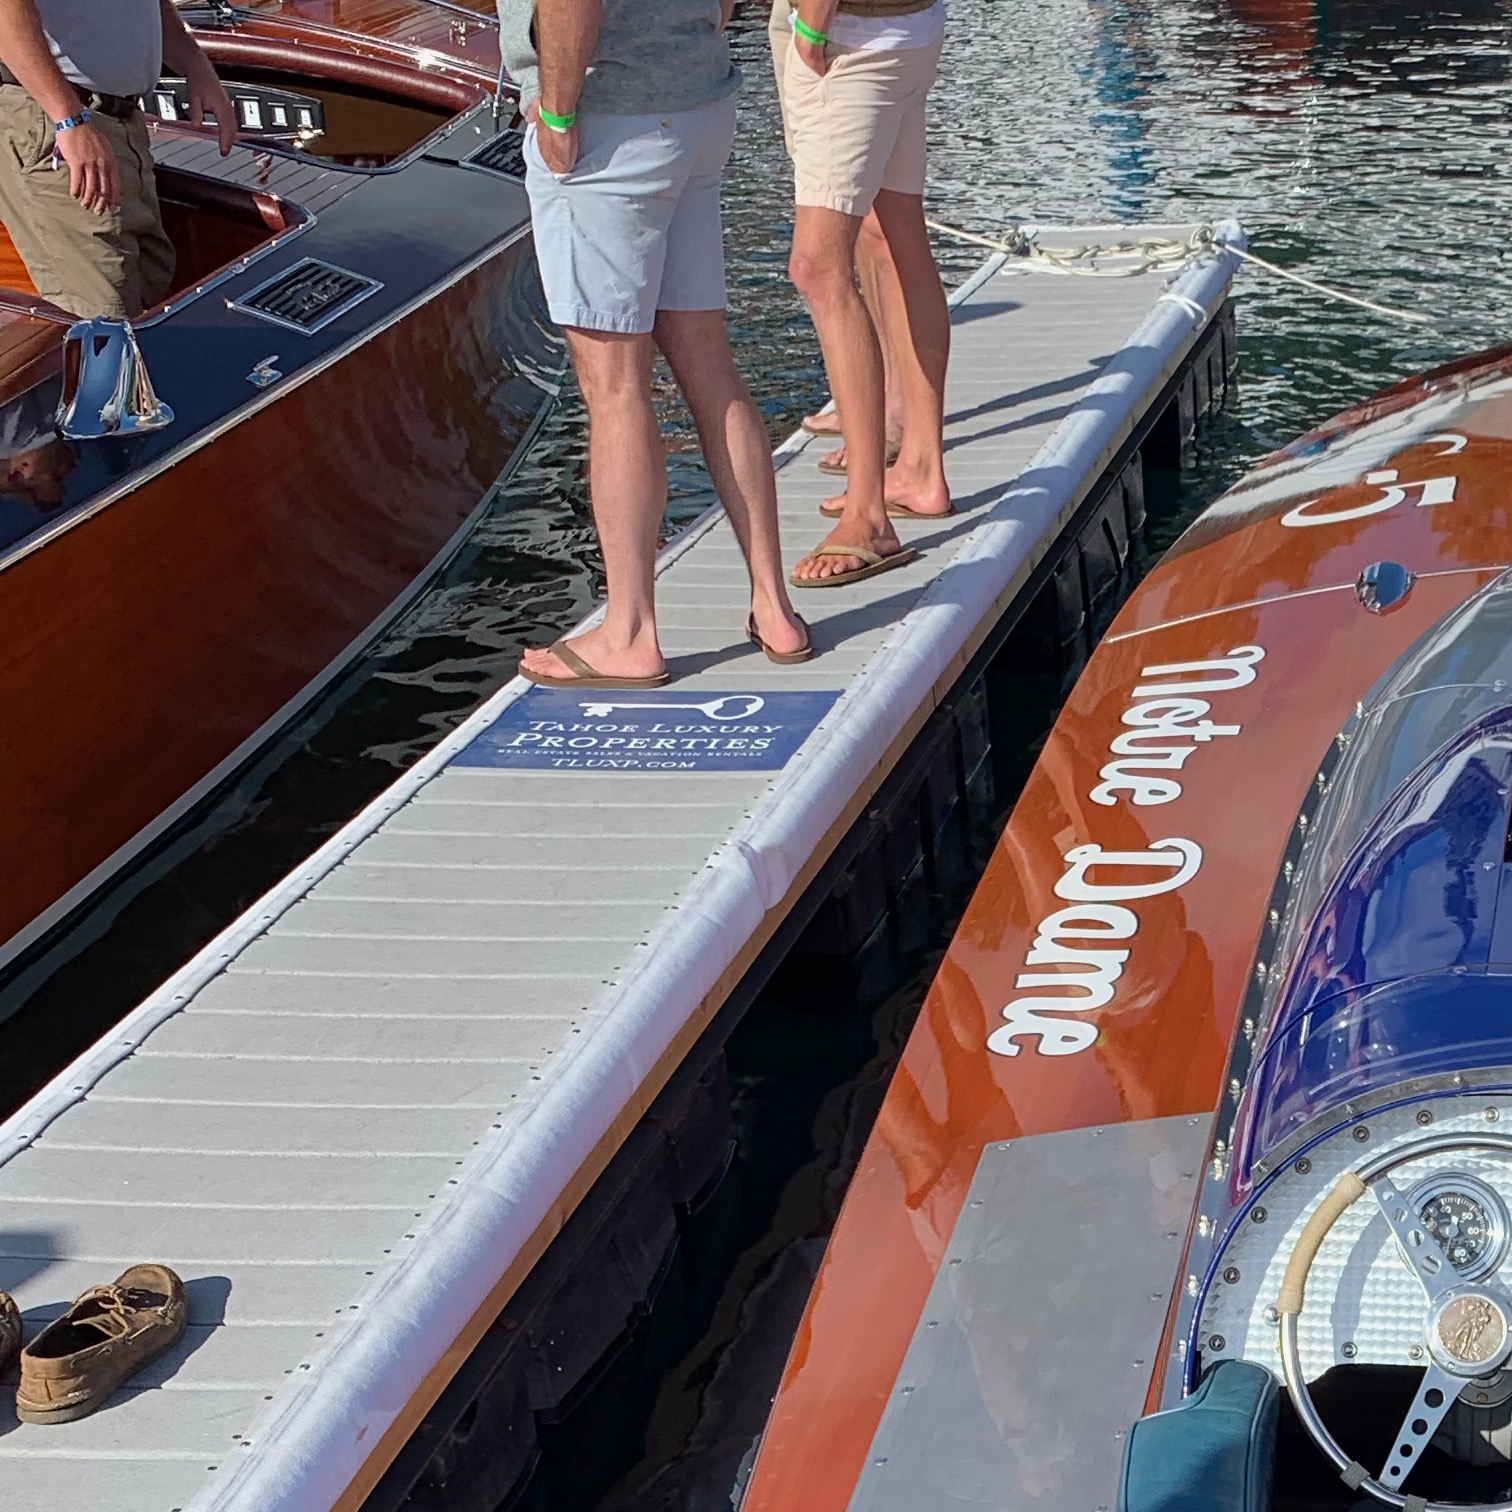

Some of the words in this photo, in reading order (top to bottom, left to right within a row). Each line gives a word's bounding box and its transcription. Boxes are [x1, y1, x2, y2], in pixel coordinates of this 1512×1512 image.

[529, 720, 639, 733] TAHOE
[647, 723, 784, 734] LUXURY
[1089, 645, 1267, 807] Notre
[506, 732, 774, 750] PROPERTIES
[986, 838, 1204, 1057] Dame
[1461, 1211, 1474, 1221] 50
[1467, 1226, 1480, 1236] 60
